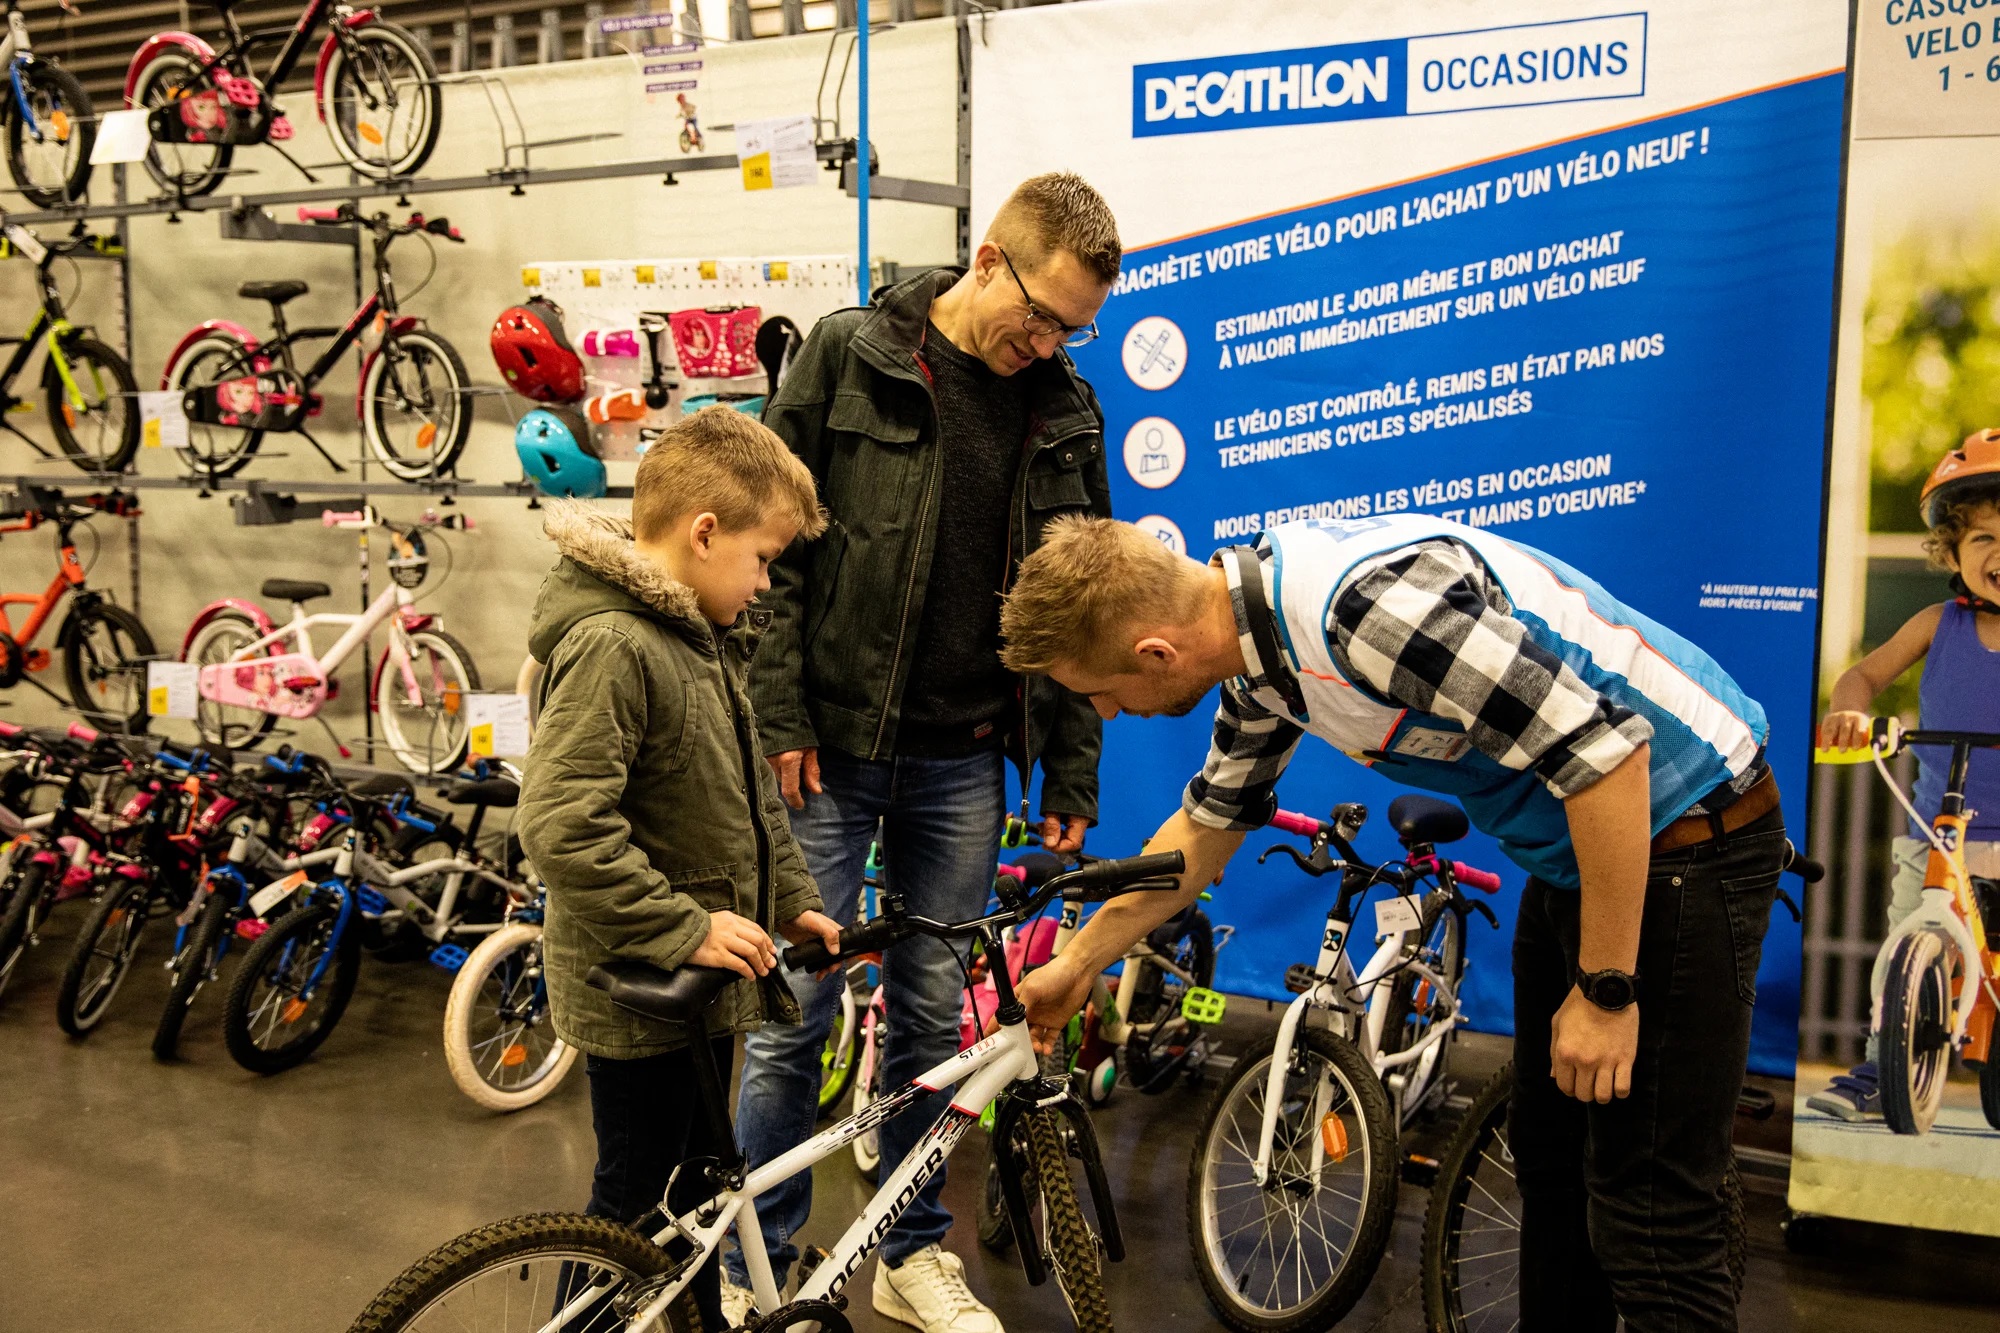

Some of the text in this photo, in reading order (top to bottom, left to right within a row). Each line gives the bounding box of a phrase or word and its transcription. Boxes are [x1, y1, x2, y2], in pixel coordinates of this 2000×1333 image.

[1886, 0, 2000, 26] CASQ
[1905, 21, 1981, 59] VELO
[1145, 41, 1629, 122] DECATHLON OCCASIONS
[1939, 65, 1950, 91] 1
[1986, 55, 2000, 82] 6
[1112, 126, 1710, 297] RACHÈTE VOTRE VÉLO POUR L'ACHAT D'UN VÉLO NEUF !
[1215, 230, 1624, 341] ESTIMATION LE JOUR MÊME ET BON D'ACHAT
[1218, 257, 1647, 370] À VALOIR IMMÉDIATEMENT SUR UN VÉLO NEUF
[1214, 333, 1665, 441] LE VÉLO EST CONTRÔLÉ, REMIS EN ÉTAT PAR NOS
[1218, 388, 1533, 469] TECHNICIENS CYCLES SPÉCIALISÉS
[1213, 453, 1611, 540] NOUS REVENDONS LES VÉLOS EN OCCASION
[1469, 498, 1533, 528] MAINS
[1699, 597, 1726, 609] HORS
[1713, 584, 1759, 597] HAUTEUR
[1759, 585, 1774, 597] DU
[1774, 586, 1799, 598] PRIX
